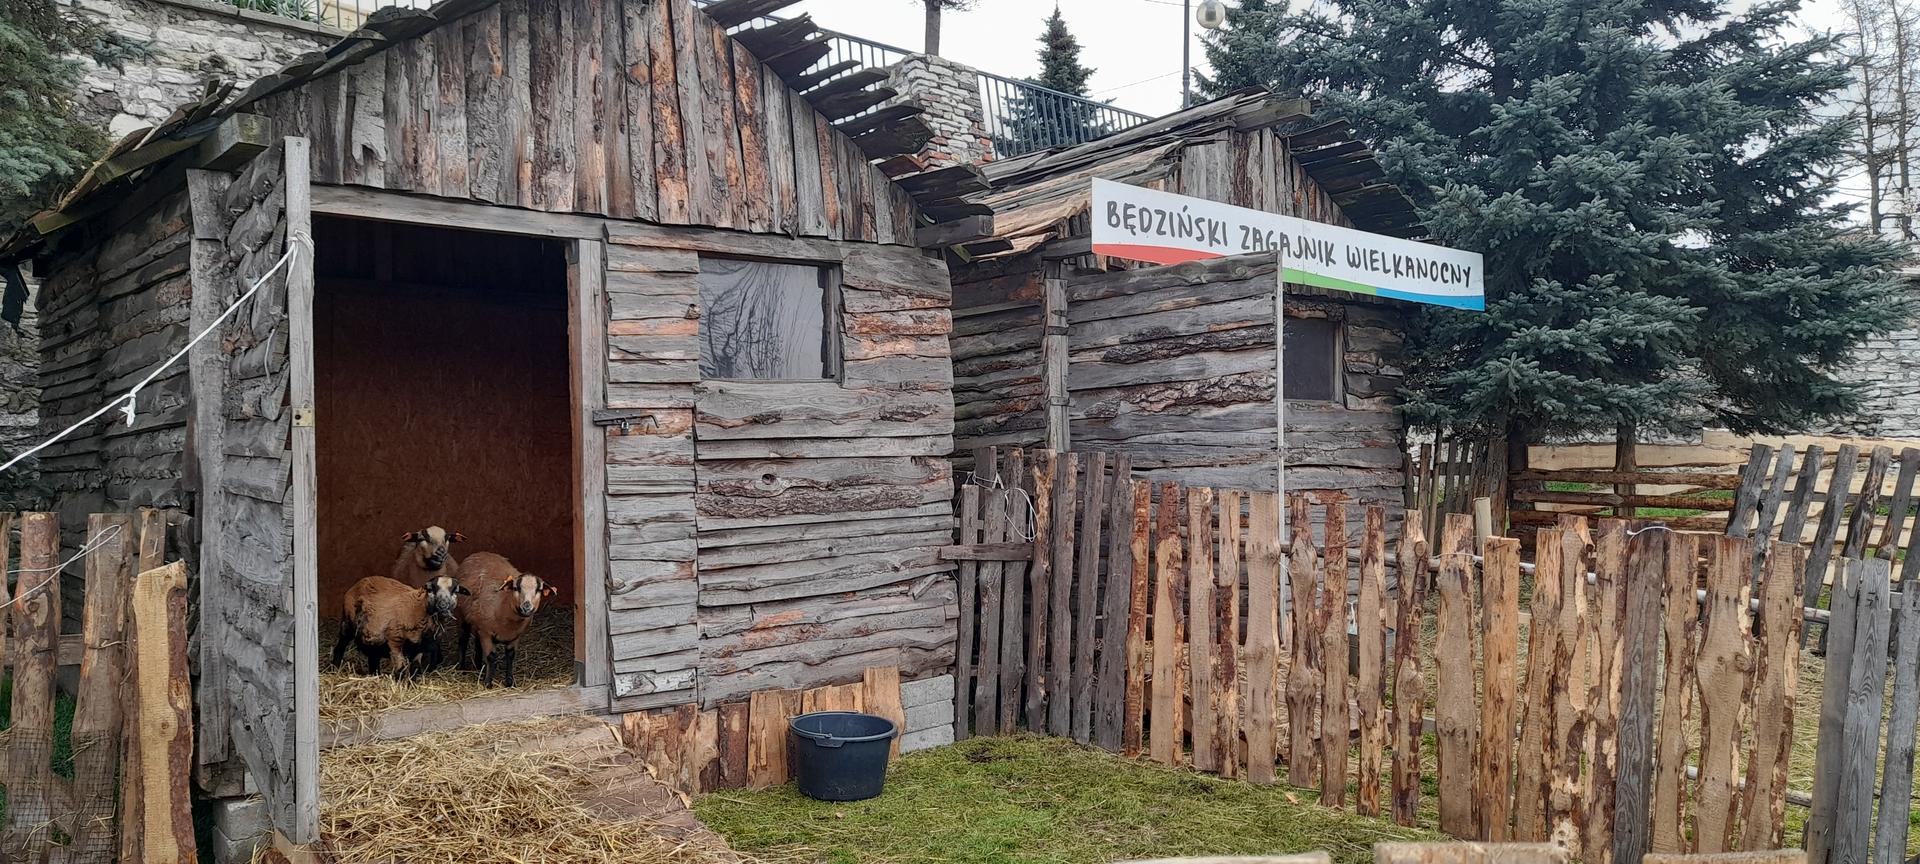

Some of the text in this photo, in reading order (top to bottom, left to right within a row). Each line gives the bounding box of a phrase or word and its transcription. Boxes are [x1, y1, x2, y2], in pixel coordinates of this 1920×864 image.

[1107, 200, 1472, 288] BĘDZIŃSKI ZAGAJNIK WIELKANOCNY
